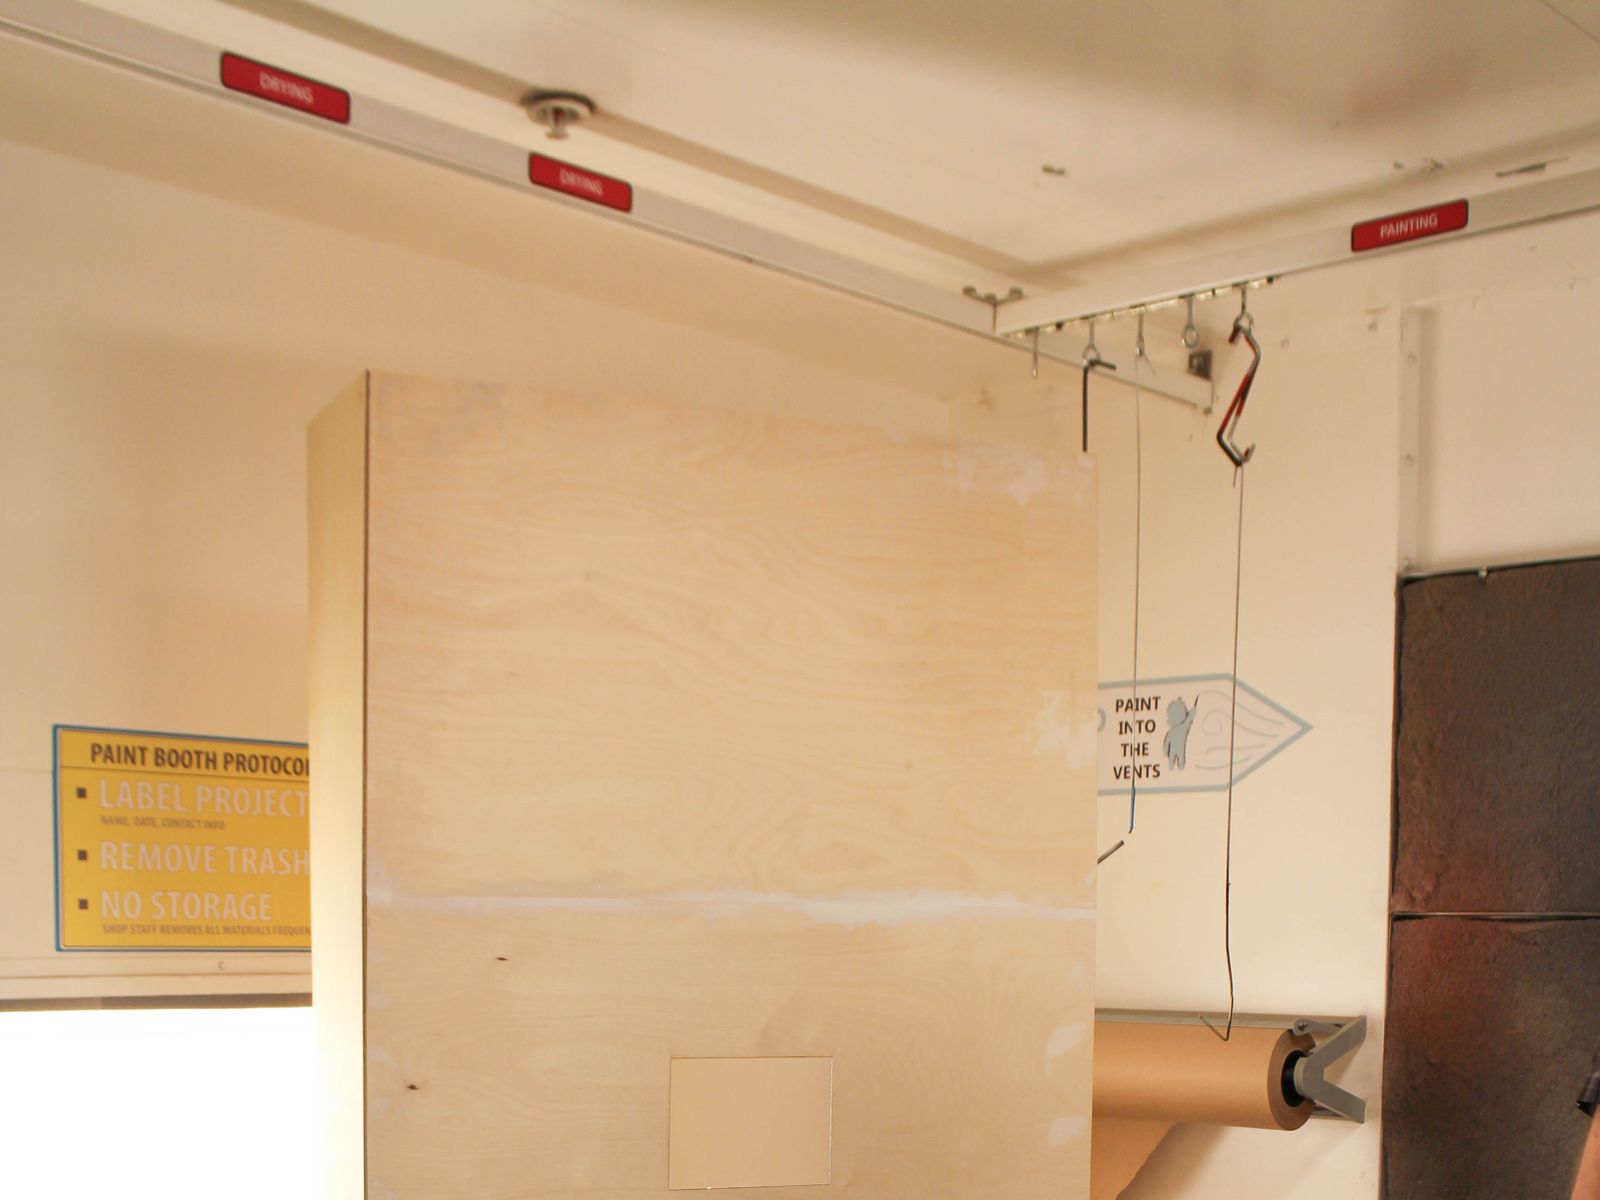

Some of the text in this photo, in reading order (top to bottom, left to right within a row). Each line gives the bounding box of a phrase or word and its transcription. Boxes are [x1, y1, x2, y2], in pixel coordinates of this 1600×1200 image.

[259, 72, 314, 104] DRYING
[559, 168, 604, 196] DRYING
[1380, 212, 1438, 240] PAINTING
[1115, 696, 1161, 713] PAINT
[1119, 719, 1156, 735] INTO
[91, 742, 148, 766] PAINT
[154, 747, 218, 771] BOOTH
[1121, 742, 1149, 757] THE
[1113, 764, 1161, 780] VENTS
[99, 779, 309, 818] LABEL PROJECT
[100, 840, 309, 876] REMOVE TRASH
[101, 890, 273, 921] NO STORAGE
